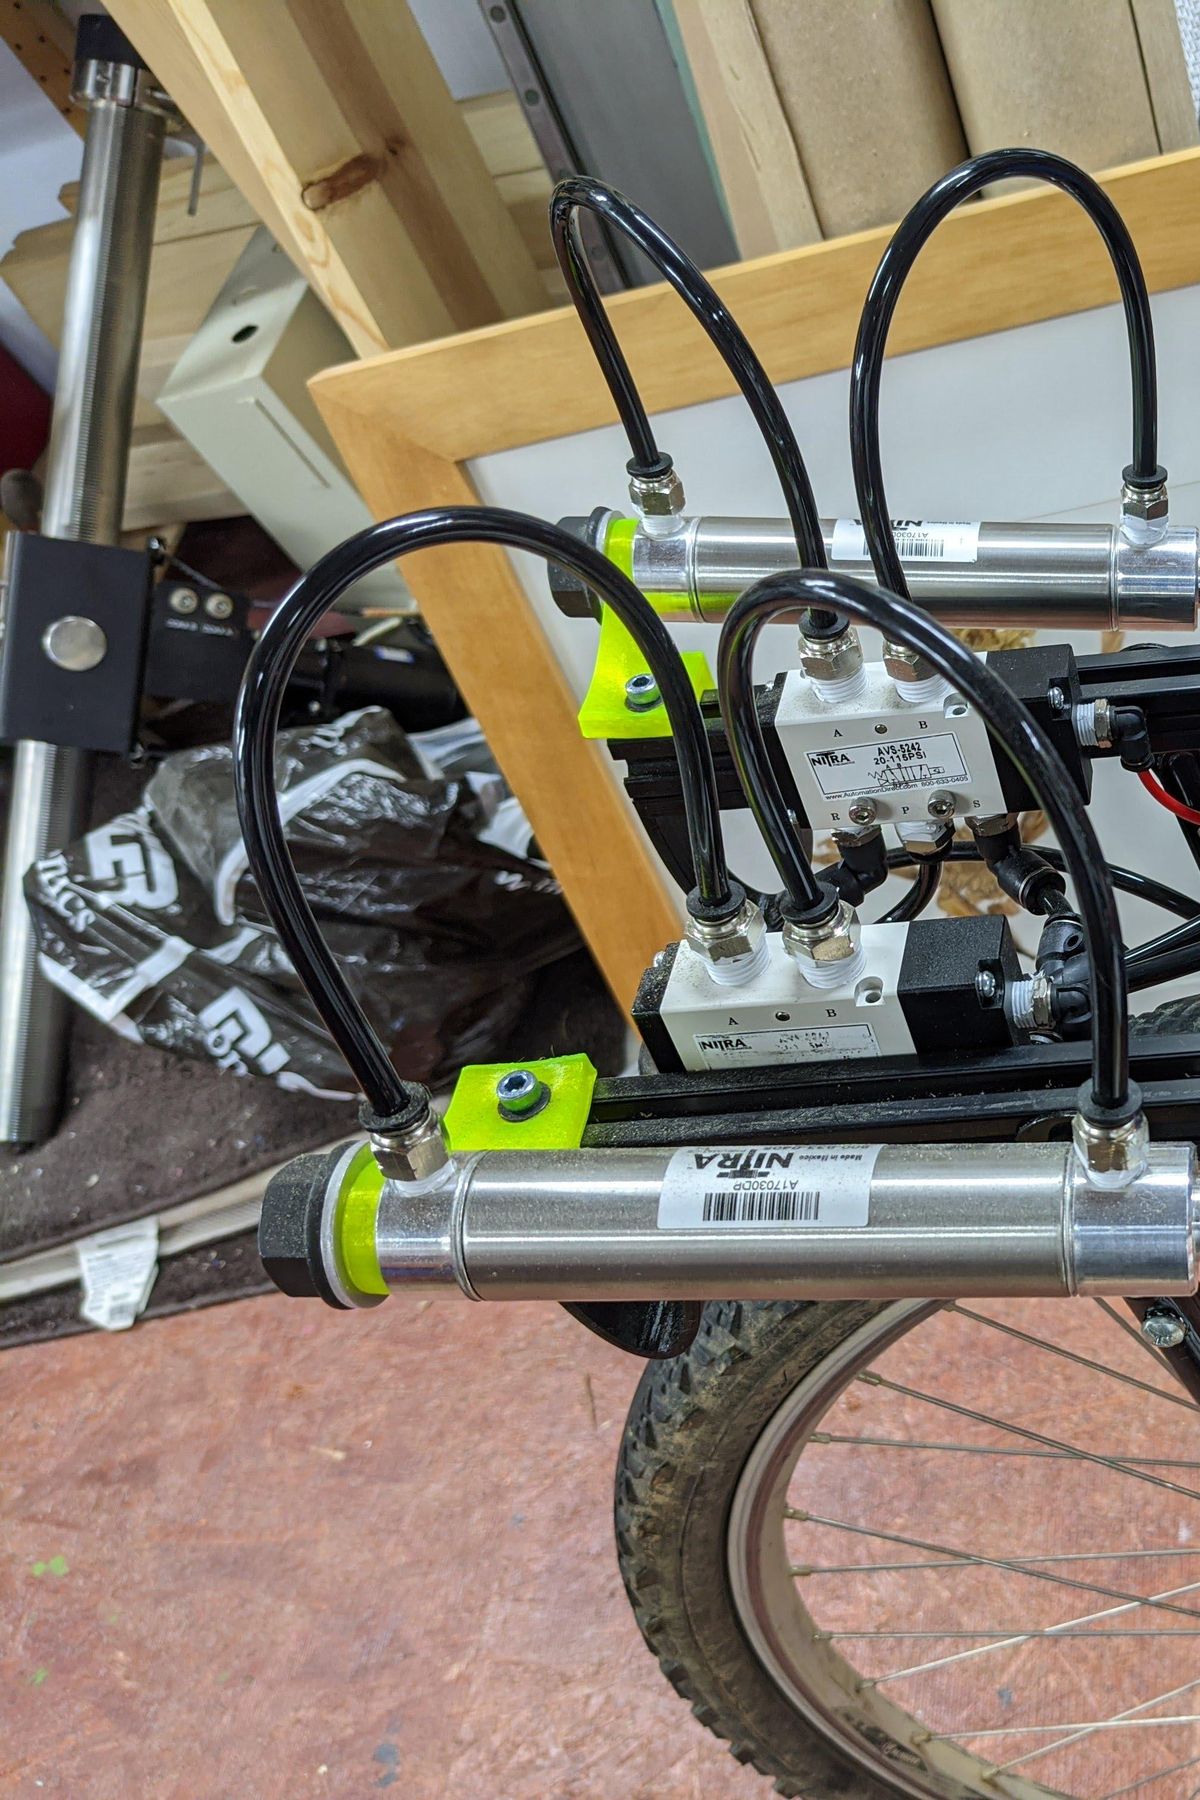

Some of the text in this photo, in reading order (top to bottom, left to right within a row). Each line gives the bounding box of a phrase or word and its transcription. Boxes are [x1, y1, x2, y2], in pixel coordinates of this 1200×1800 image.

[833, 720, 928, 737] A B
[877, 742, 922, 756] AVS-5242
[811, 751, 850, 767] NITRA
[873, 752, 927, 765] 20-115PSI
[831, 800, 981, 821] R P S
[728, 1008, 837, 1026] A B
[701, 1037, 747, 1051] NITRA
[694, 1149, 794, 1178] NITRA
[733, 1179, 798, 1191] A17030DP
